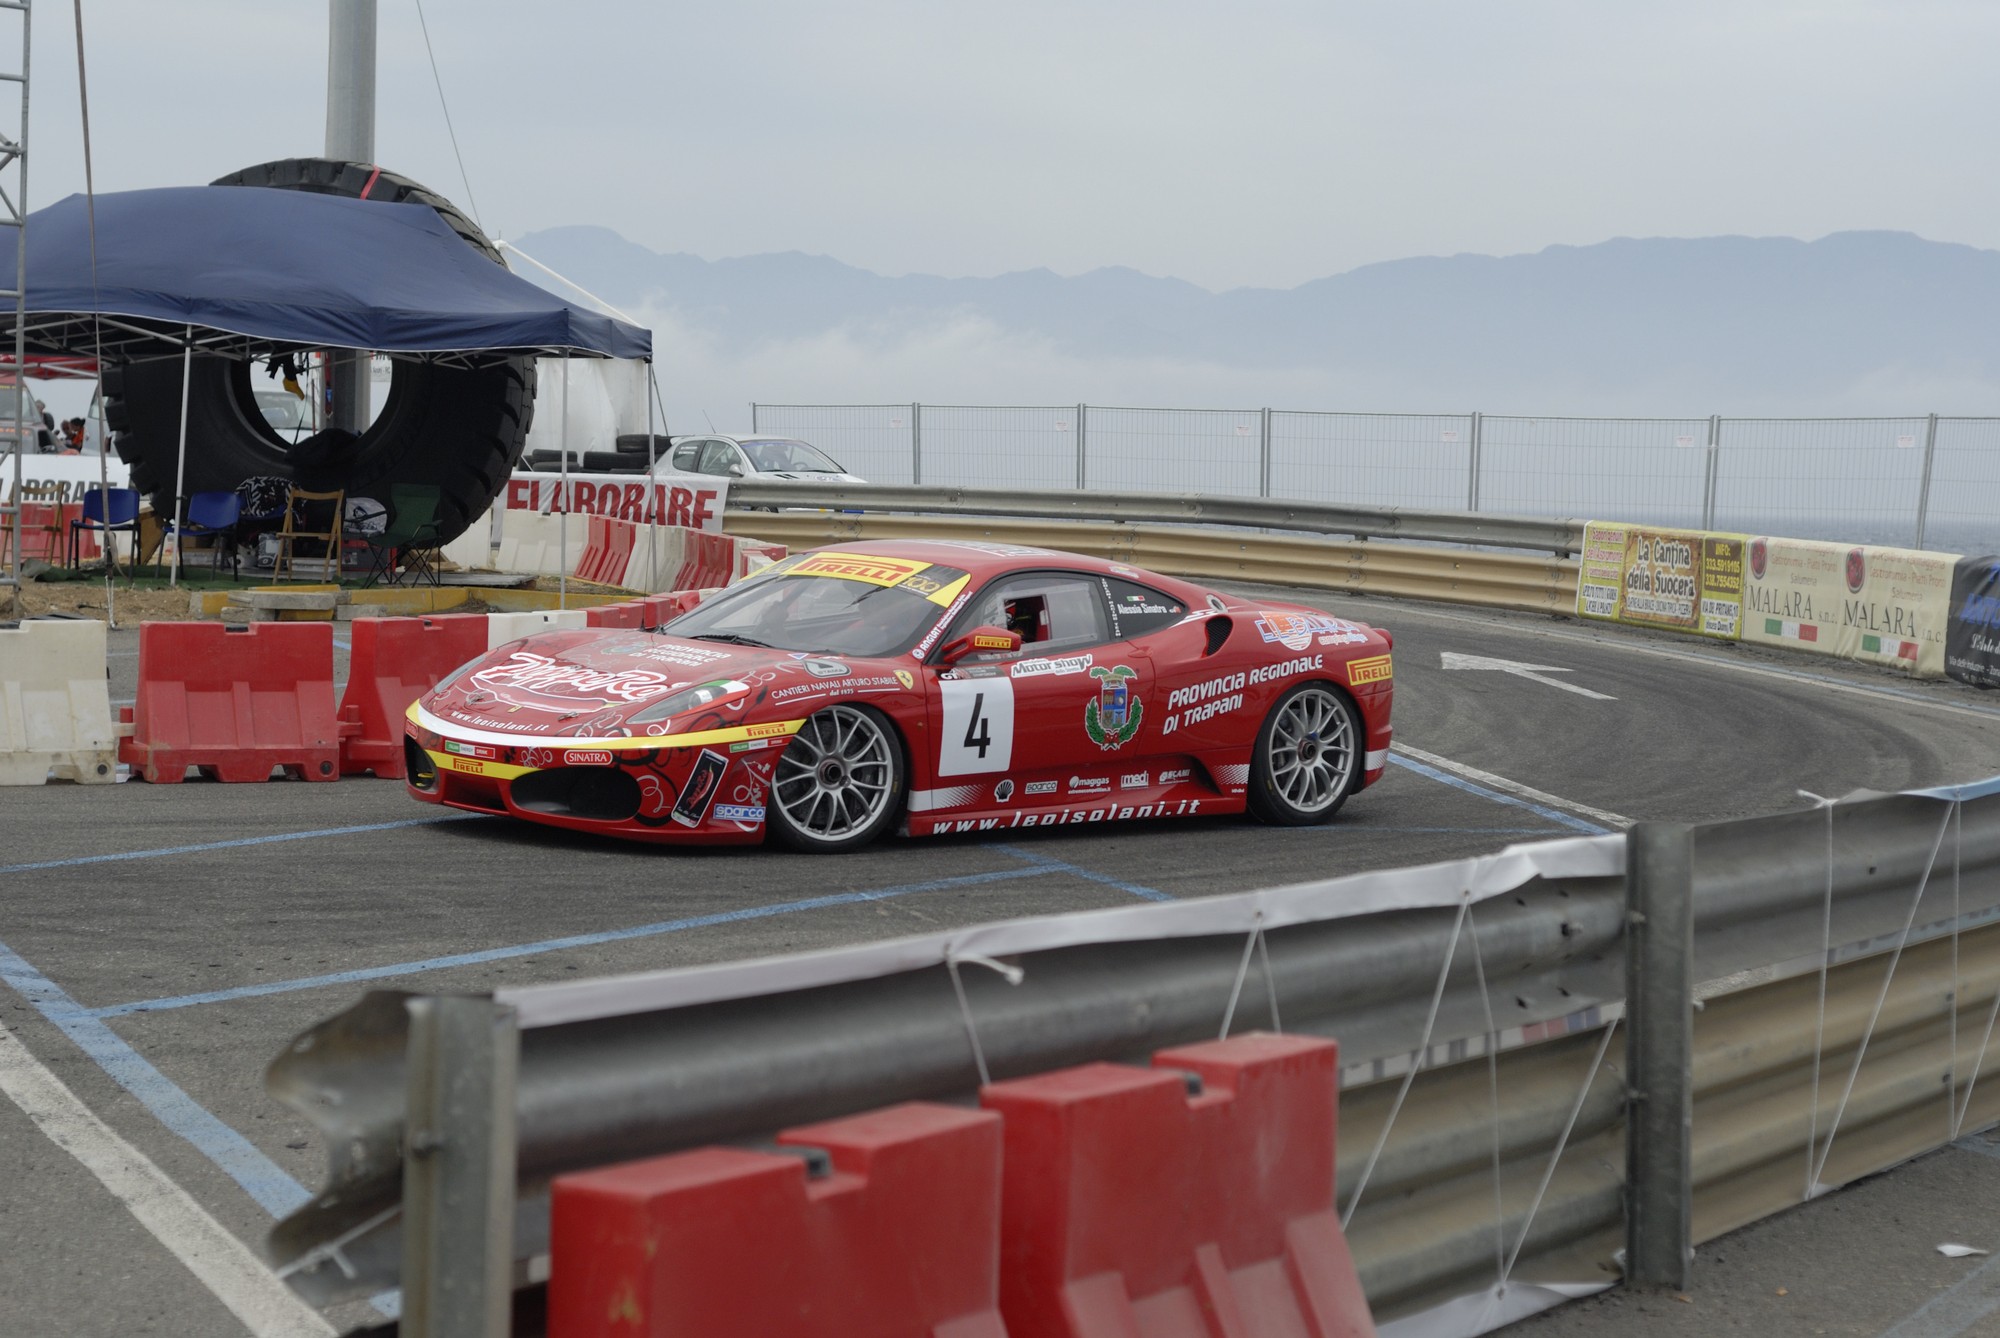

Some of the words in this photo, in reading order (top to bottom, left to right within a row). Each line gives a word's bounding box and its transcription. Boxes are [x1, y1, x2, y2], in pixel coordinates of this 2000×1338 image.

[1638, 537, 1650, 561] La
[1655, 539, 1690, 570] Cantina
[1715, 543, 1731, 557] INFO:
[794, 557, 914, 582] PIRELLI
[1628, 567, 1650, 592] della
[1655, 570, 1695, 597] Suocera
[1116, 603, 1143, 615] Alessia
[1140, 602, 1168, 614] Sinatra
[1748, 585, 1814, 620] MALARA
[1843, 599, 1917, 638] MALARA
[976, 638, 1010, 648] PIRELLI
[1013, 661, 1052, 677] Motor
[1054, 655, 1092, 671] show
[1348, 657, 1393, 684] PIRELLI
[771, 685, 810, 699] CANTIERI
[811, 682, 841, 692] NAVALI
[842, 677, 872, 687] ARTURO
[871, 676, 899, 686] STABILE
[1167, 672, 1246, 711] PROVINCIA
[1249, 654, 1324, 686] REGIONALE
[963, 692, 991, 759] 4
[1162, 714, 1180, 736] DI
[1184, 693, 1244, 728] TRAPANI
[746, 723, 786, 737] PIRELLI
[453, 757, 484, 774] PIRELLI
[569, 752, 608, 763] SINATRA
[1026, 781, 1057, 794] sparco
[716, 806, 765, 820] sparco
[932, 799, 1201, 835] www.leoisolani.it
